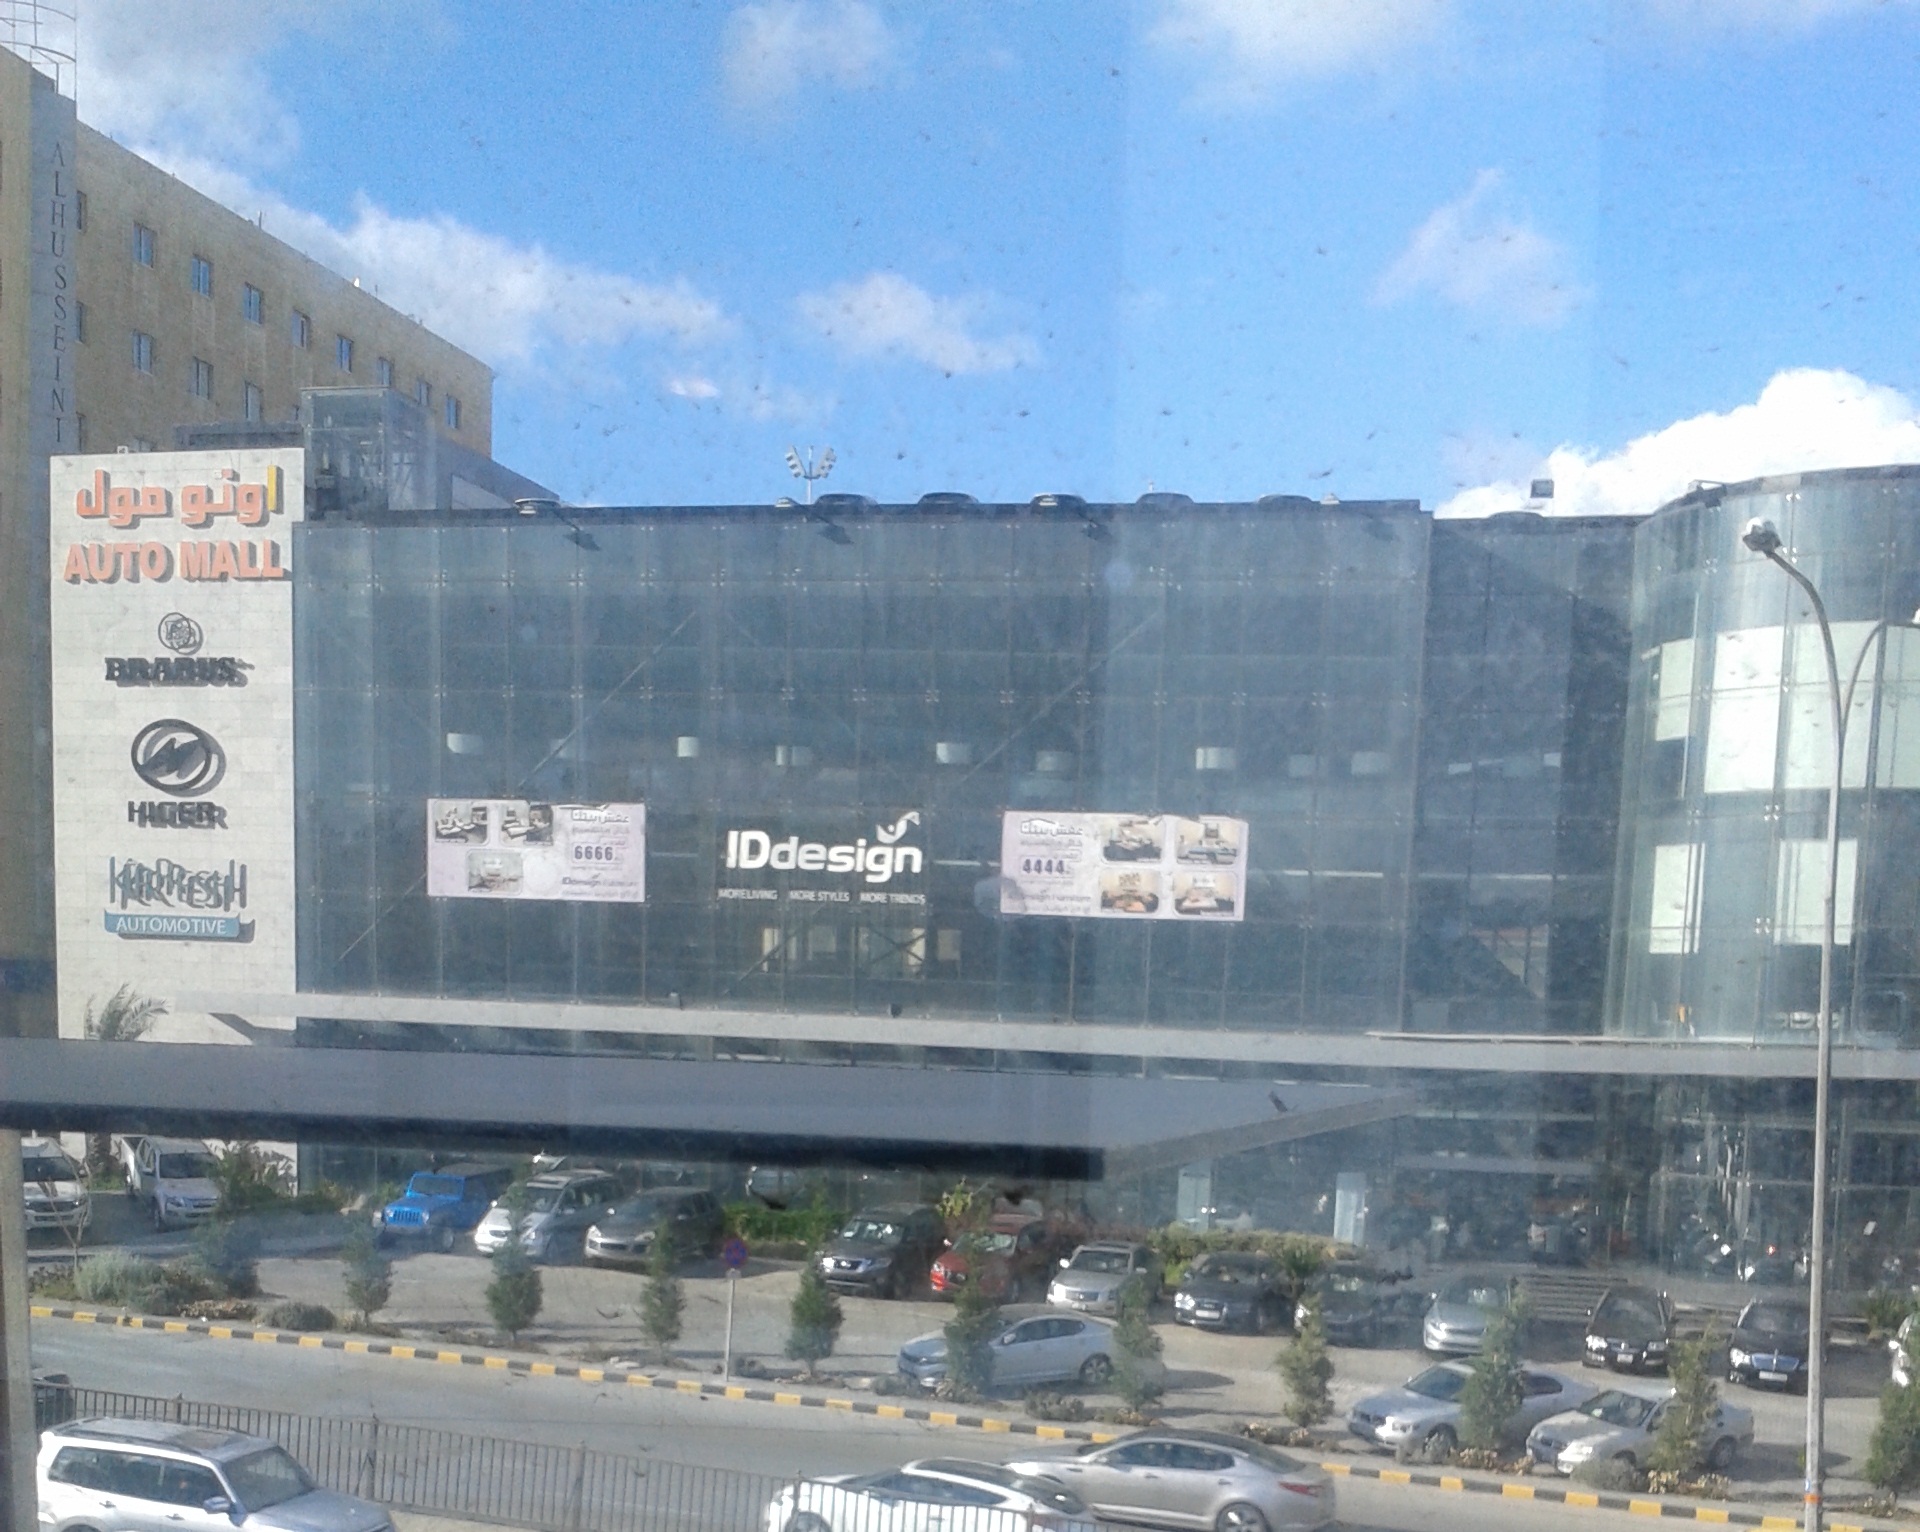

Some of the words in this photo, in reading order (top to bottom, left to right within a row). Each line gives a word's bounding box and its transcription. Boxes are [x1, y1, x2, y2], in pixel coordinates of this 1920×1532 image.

[76, 469, 168, 527] مول
[63, 541, 169, 582] AUTO
[179, 539, 286, 580] MALL
[573, 844, 614, 861] 6666
[726, 830, 923, 883] IDdesign
[1021, 858, 1065, 875] 4444
[789, 890, 816, 901] MORE
[817, 891, 850, 902] STYLES
[860, 892, 887, 903] MORE
[116, 917, 227, 935] AUTOMOTIVE
